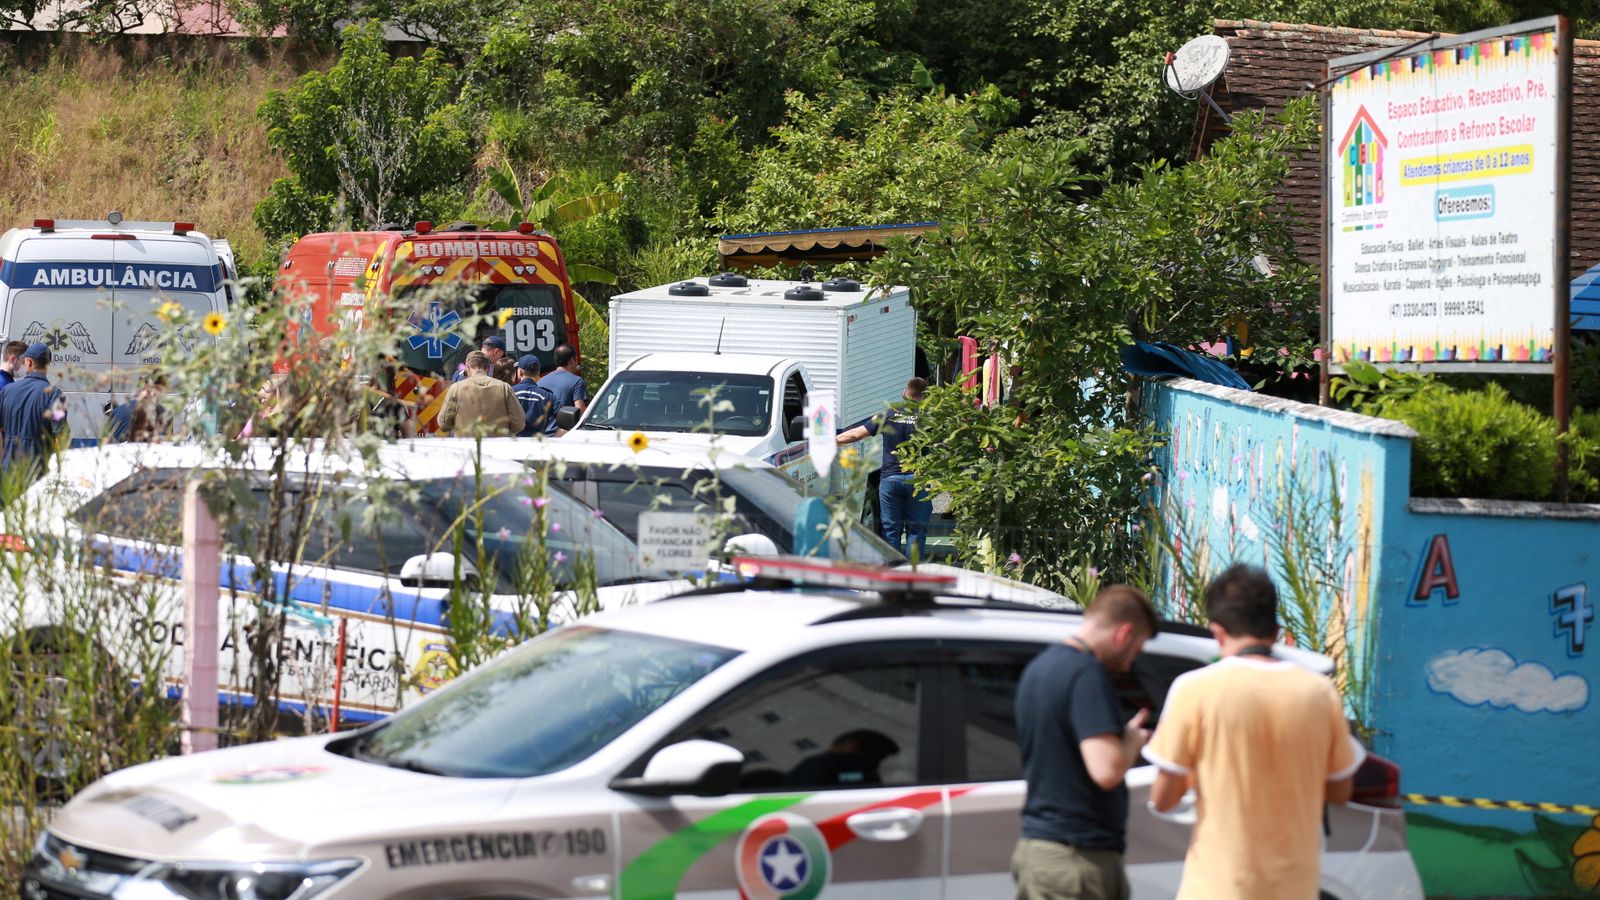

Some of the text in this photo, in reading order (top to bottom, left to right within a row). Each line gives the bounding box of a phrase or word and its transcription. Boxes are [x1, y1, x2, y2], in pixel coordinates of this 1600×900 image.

[1420, 91, 1466, 115] Educativo,
[1469, 84, 1524, 106] Recreativo,
[1451, 129, 1457, 141] e
[1500, 112, 1536, 135] Escolar
[1404, 161, 1441, 179] Atendemos
[1475, 156, 1485, 171] de
[1486, 155, 1491, 169] 0
[1500, 153, 1508, 166] 12
[1511, 153, 1530, 166] anos
[1438, 197, 1491, 214] Oferecemos:
[414, 241, 539, 258] BOMBEIROS
[1408, 238, 1424, 251] Ballet
[1429, 236, 1444, 250] Artes
[1445, 234, 1466, 248] Visuais
[1471, 233, 1488, 246] Aulas
[1490, 232, 1497, 245] de
[1499, 231, 1518, 244] Teatro
[1457, 254, 1494, 267] Treinamento
[1496, 251, 1526, 265] Funcional
[33, 265, 197, 289] AMBULÂNCIA
[1493, 271, 1541, 289] Psicopedagoga
[500, 305, 554, 316] EERGÊNCIA
[503, 318, 555, 352] 193
[64, 354, 81, 363] Vida
[649, 524, 702, 535] FAVOR NÃO
[642, 538, 693, 546] ARRANCAR
[656, 549, 692, 557] FLORES
[1410, 533, 1460, 604] A
[1551, 581, 1595, 655] 7
[384, 828, 607, 869] EMERGÊNCIA 190
